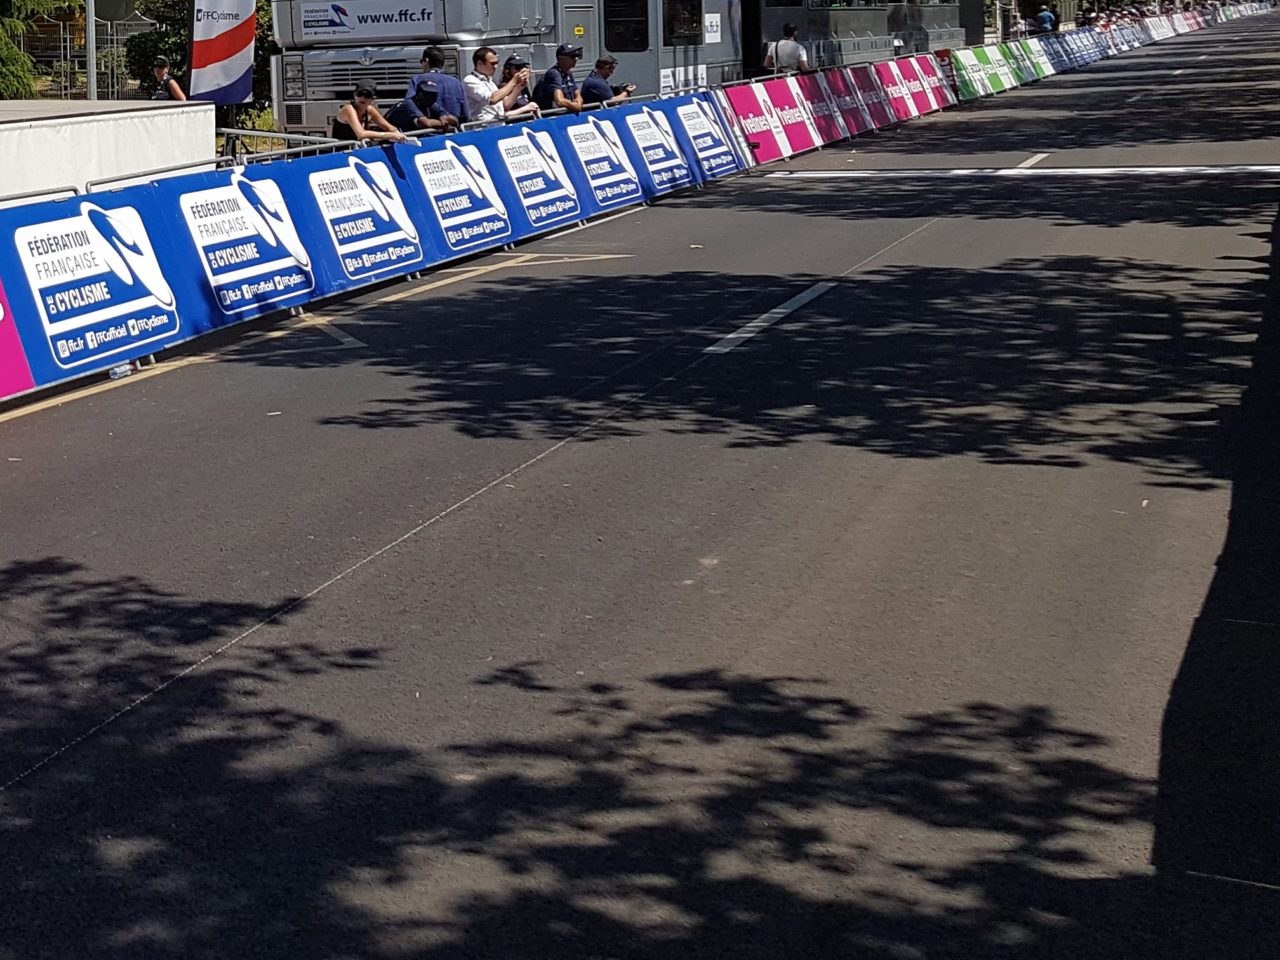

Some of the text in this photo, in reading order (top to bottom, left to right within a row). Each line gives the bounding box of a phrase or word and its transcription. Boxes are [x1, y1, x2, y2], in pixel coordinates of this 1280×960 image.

[356, 8, 433, 24] www.ffc.fr
[317, 176, 359, 197] FÉDÉRATION
[190, 198, 241, 220] FÉDÉRATION
[198, 216, 249, 240] FRANÇAISE
[339, 217, 376, 238] CYCLISME
[27, 229, 91, 258] FÉDÉRATION
[215, 242, 260, 267] CYCLISME
[35, 251, 100, 280] FRANÇAISE
[46, 281, 112, 314] DE CYCLISME
[95, 323, 128, 344] FFCofficiel
[137, 314, 169, 332] FFCyclisme
[68, 336, 85, 353] ffc.fr
